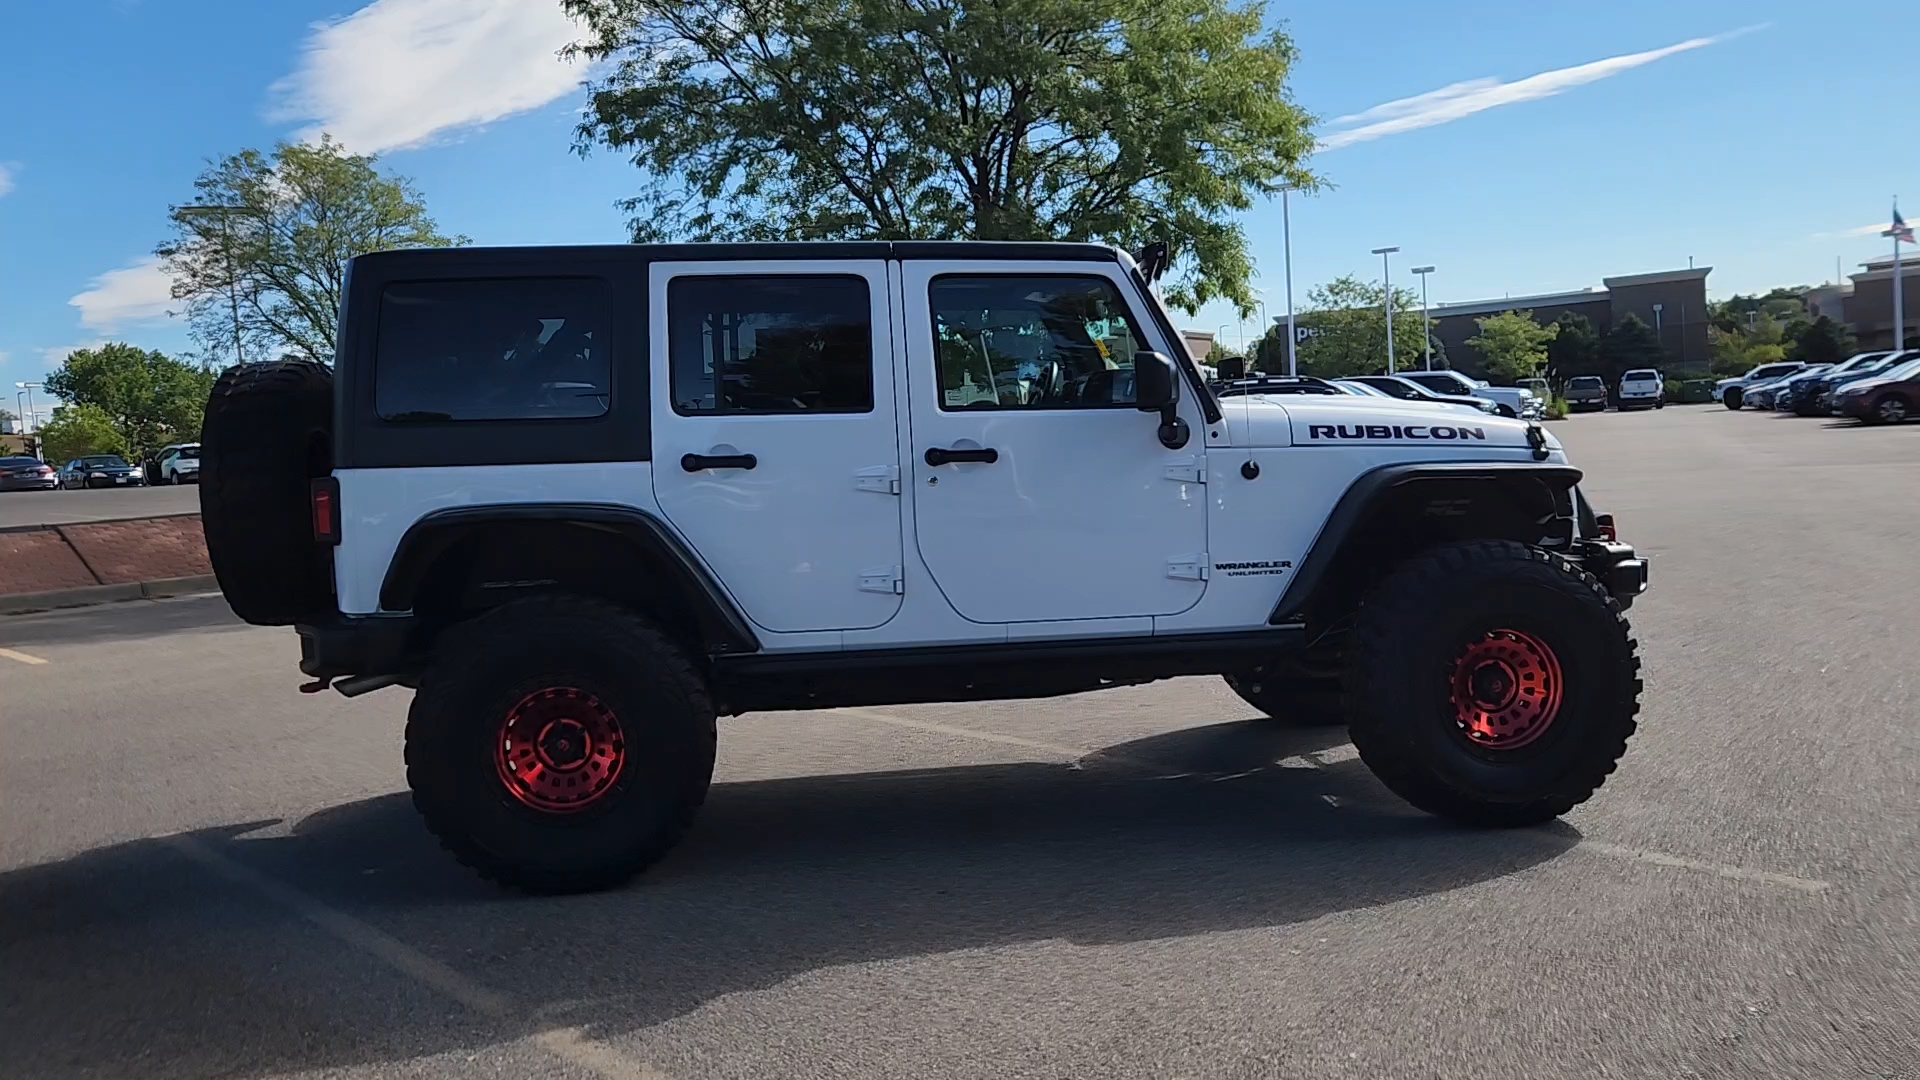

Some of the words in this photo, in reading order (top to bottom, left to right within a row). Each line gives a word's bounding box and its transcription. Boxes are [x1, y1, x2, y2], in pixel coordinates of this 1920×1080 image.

[1308, 424, 1486, 440] RUBICON
[1215, 560, 1292, 570] WRANGLER
[1227, 569, 1283, 577] UNLIMITED
